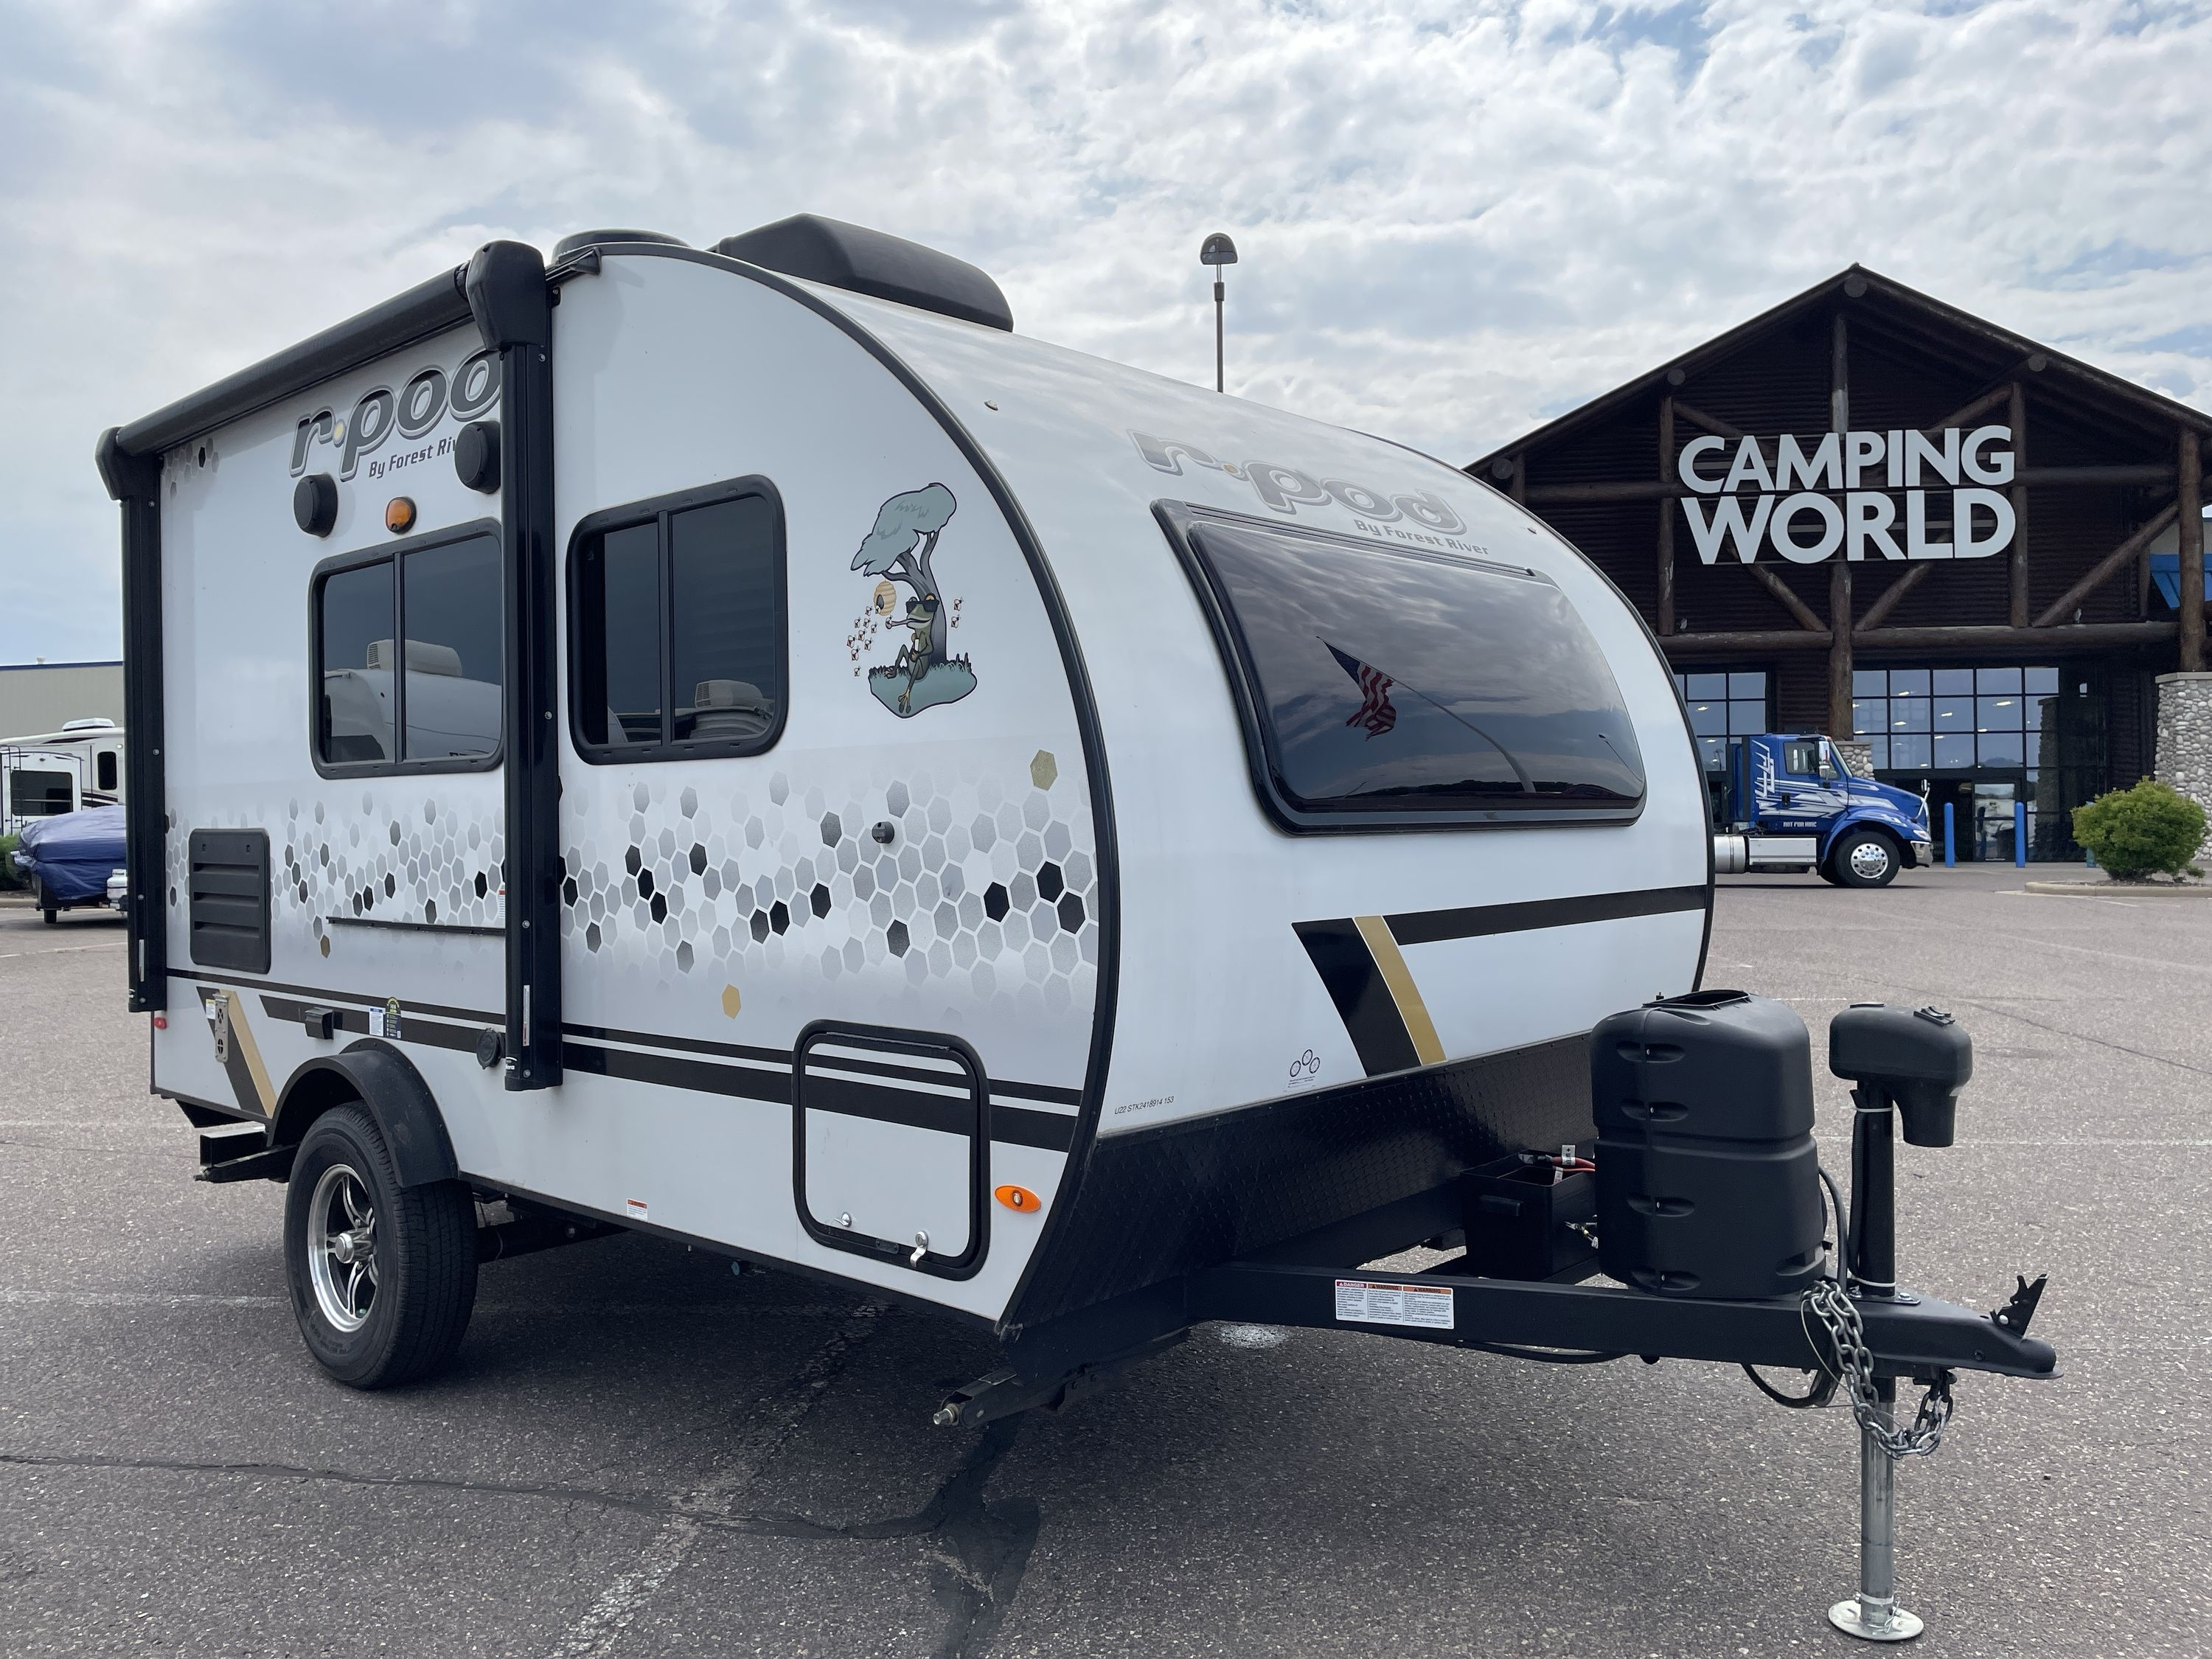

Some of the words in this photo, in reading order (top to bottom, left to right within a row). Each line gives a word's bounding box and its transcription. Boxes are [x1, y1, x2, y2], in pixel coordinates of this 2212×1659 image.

[369, 460, 386, 479] By
[389, 445, 434, 471] Forest
[1677, 425, 2015, 494] CAMPING
[1354, 519, 1382, 536] By
[1382, 525, 1444, 546] Forest
[1445, 538, 1489, 554] River
[1680, 487, 2017, 565] WORLD
[1164, 1096, 1175, 1104] 153
